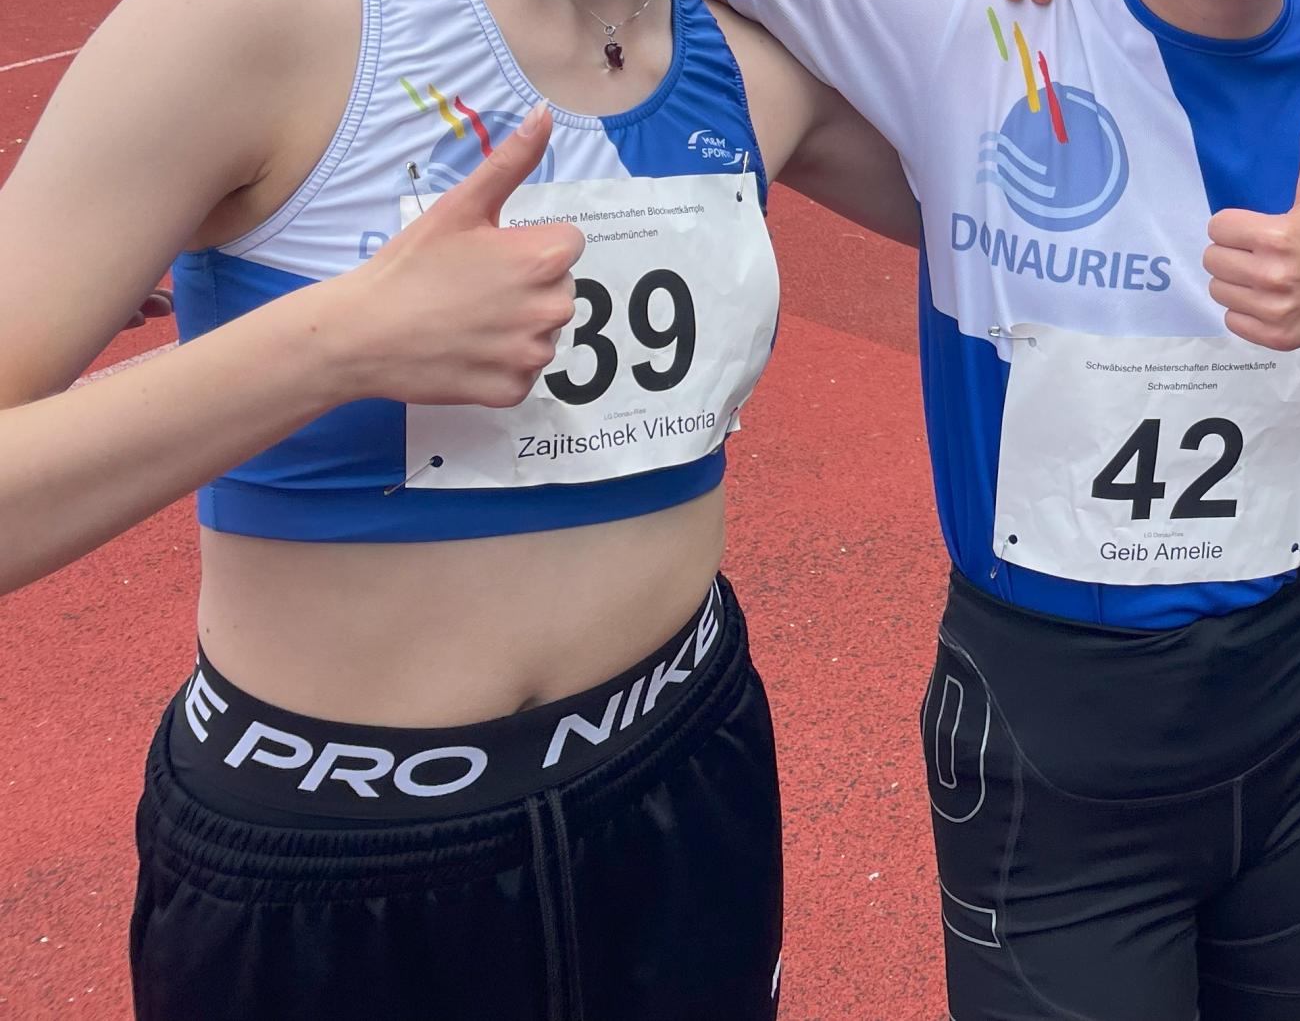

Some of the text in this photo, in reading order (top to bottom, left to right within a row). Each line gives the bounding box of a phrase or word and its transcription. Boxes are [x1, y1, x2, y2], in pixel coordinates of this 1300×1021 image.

[509, 214, 578, 228] Schwäbische
[580, 209, 646, 223] Meisterschaften
[586, 228, 659, 244] Schwabmünchen
[951, 210, 1172, 293] DONAURIES
[544, 269, 697, 406] 39
[1085, 360, 1277, 373] Schwäbische Meisterschaften Blockwettkämpfe
[1147, 381, 1218, 391] Schwabmünchen
[517, 410, 716, 460] Zajitschek Viktoria
[1091, 417, 1245, 521] 42
[1100, 540, 1224, 561] Geib Amelie
[223, 720, 489, 799] PRO
[541, 584, 720, 769] NIKE
